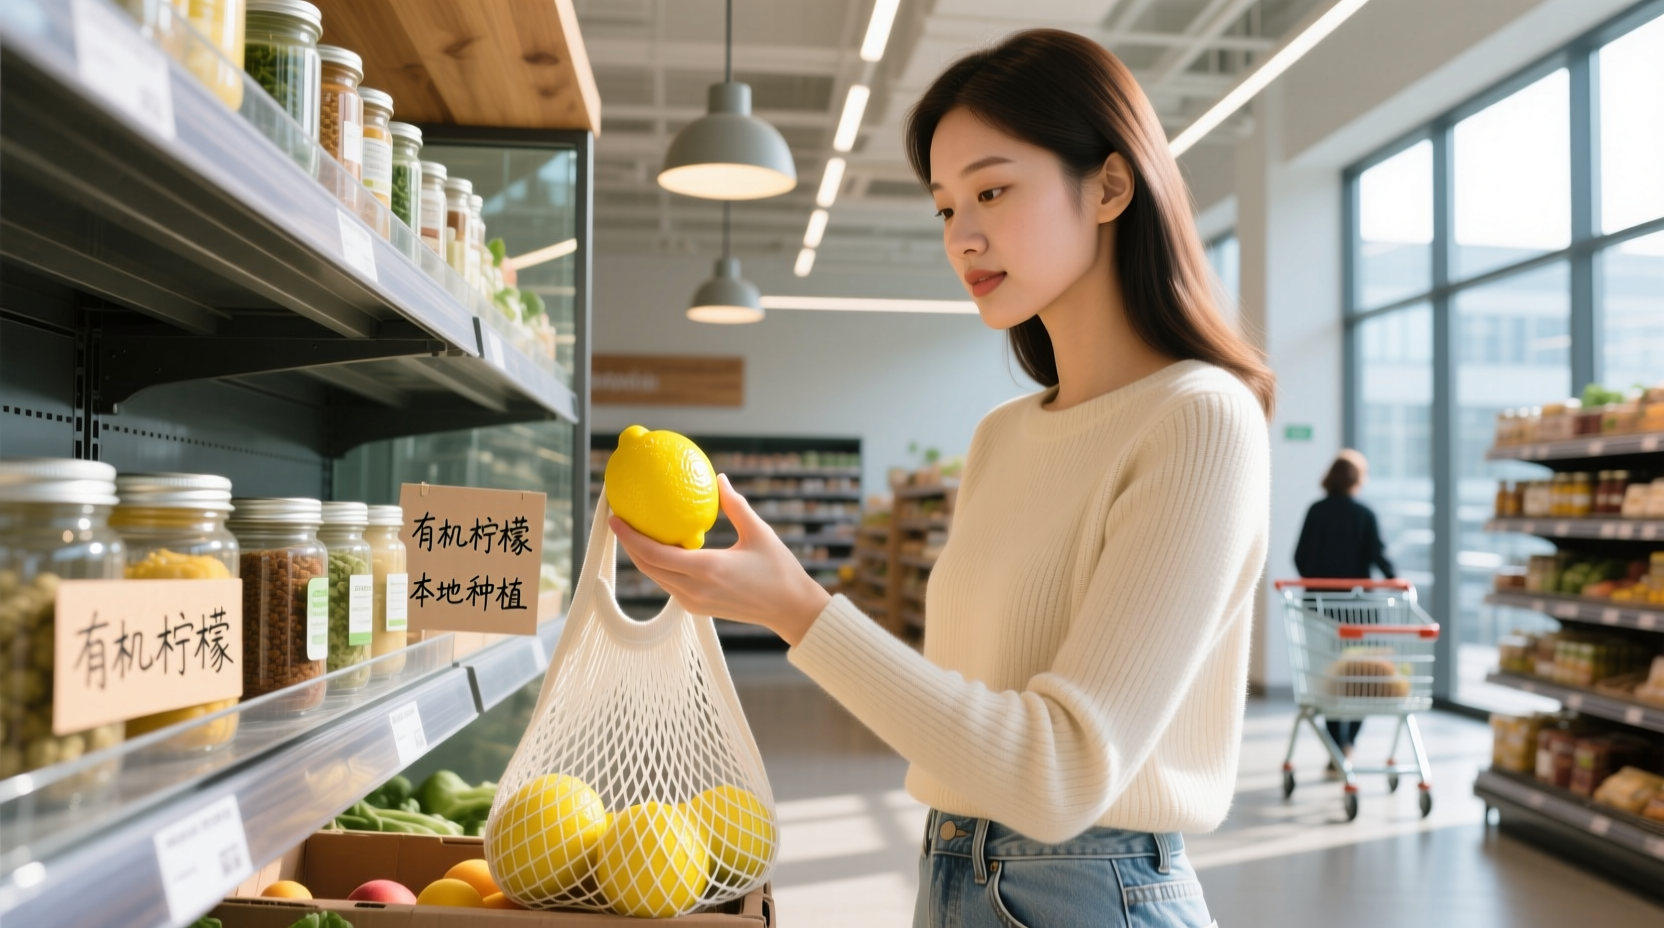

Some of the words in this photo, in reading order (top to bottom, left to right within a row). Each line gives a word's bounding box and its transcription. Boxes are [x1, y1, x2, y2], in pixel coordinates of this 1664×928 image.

[411, 511, 533, 556] 有机柠檬
[409, 571, 528, 612] 本地种植
[75, 606, 234, 689] 有机柠檬
